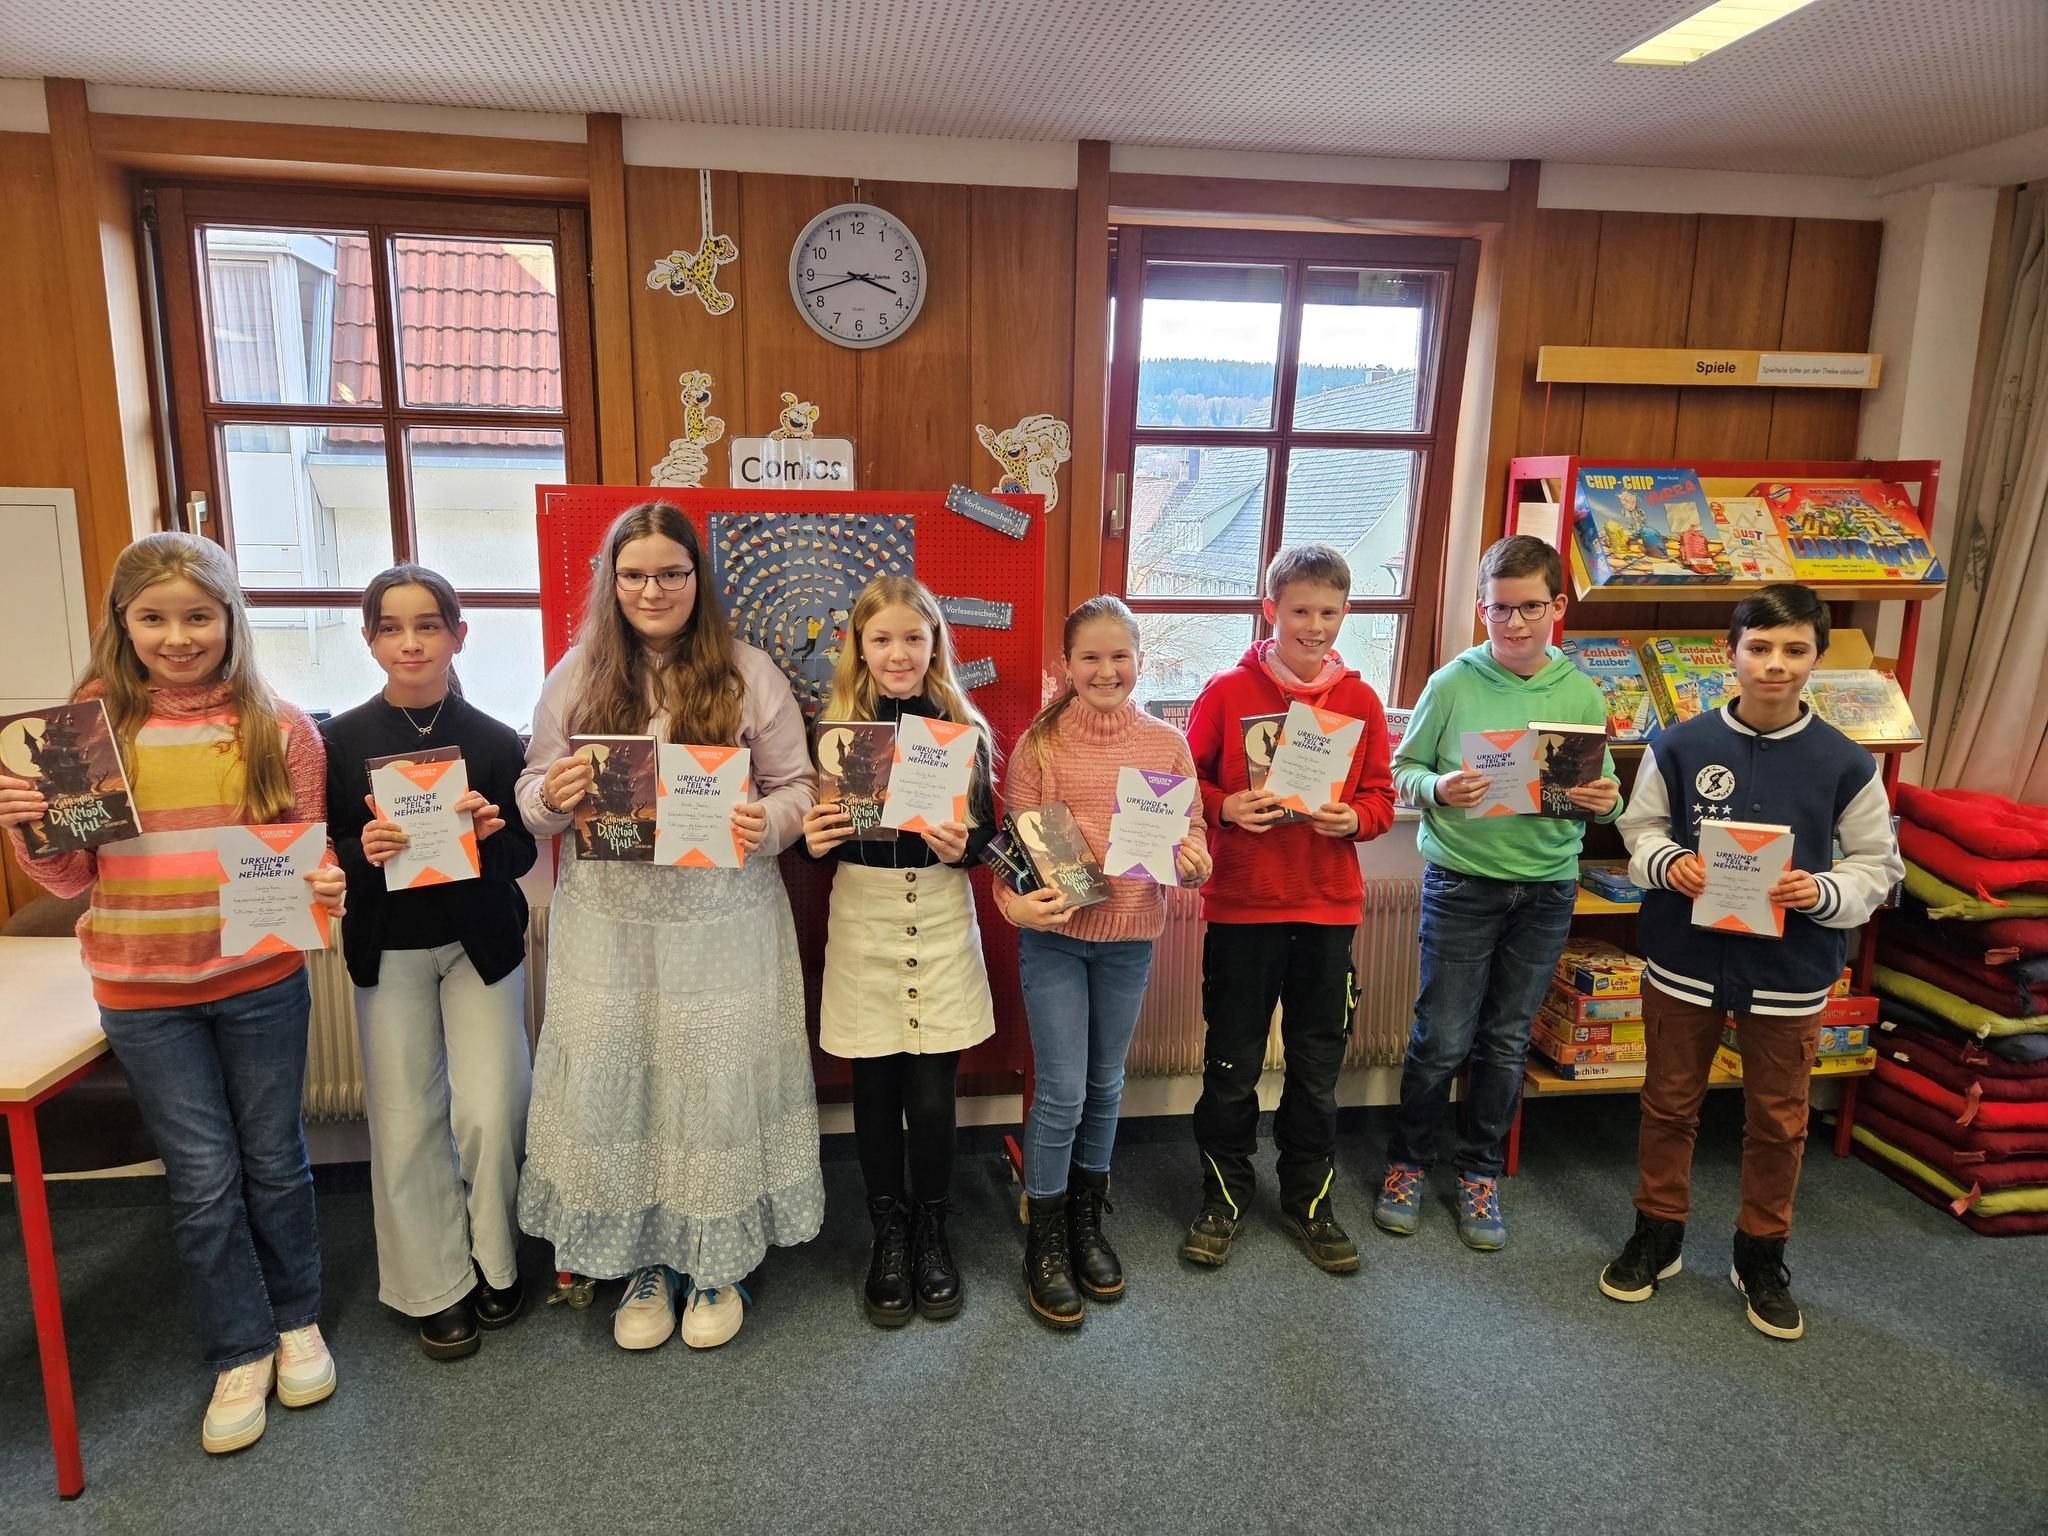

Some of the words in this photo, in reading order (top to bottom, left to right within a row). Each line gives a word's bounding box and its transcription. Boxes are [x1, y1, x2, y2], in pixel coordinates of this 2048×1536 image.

[850, 222, 865, 235] 12
[829, 229, 841, 241] 11
[879, 230, 885, 242] 1
[812, 247, 827, 260] 10
[894, 249, 903, 261] 2
[806, 268, 815, 281] 9
[902, 271, 911, 283] 3
[816, 295, 825, 307] 8
[895, 297, 903, 309] 4
[833, 313, 841, 324] 7
[879, 313, 887, 325] 5
[855, 320, 863, 331] 6
[1695, 361, 1737, 375] Spiele
[741, 456, 842, 483] Comics
[1585, 474, 1655, 490] CHIP-CHIP
[1733, 529, 1763, 541] JUST
[1582, 647, 1631, 657] Zahlen-
[1678, 646, 1721, 654] Entdecke
[1588, 658, 1630, 666] Zauber
[1690, 654, 1726, 665] Welt
[1162, 707, 1185, 717] WHAT
[1297, 729, 1332, 744] URKUNDE
[911, 744, 949, 757] URKUNDE
[677, 774, 719, 784] URKUNDE
[394, 792, 438, 805] URKUNDE
[1126, 796, 1162, 808] URKUNDE
[406, 801, 423, 809] TEIL
[48, 800, 112, 827] DARKMOOR
[70, 817, 102, 842] HALL
[596, 822, 642, 843] DARKMOOR
[852, 817, 874, 836] HALL
[610, 837, 633, 857] HALL
[240, 855, 290, 865] URKUNDE
[1716, 851, 1759, 862] URKUNDE
[1725, 858, 1742, 866] TEIL
[253, 863, 272, 871] TEIL
[1596, 1044, 1630, 1053] Englisch
